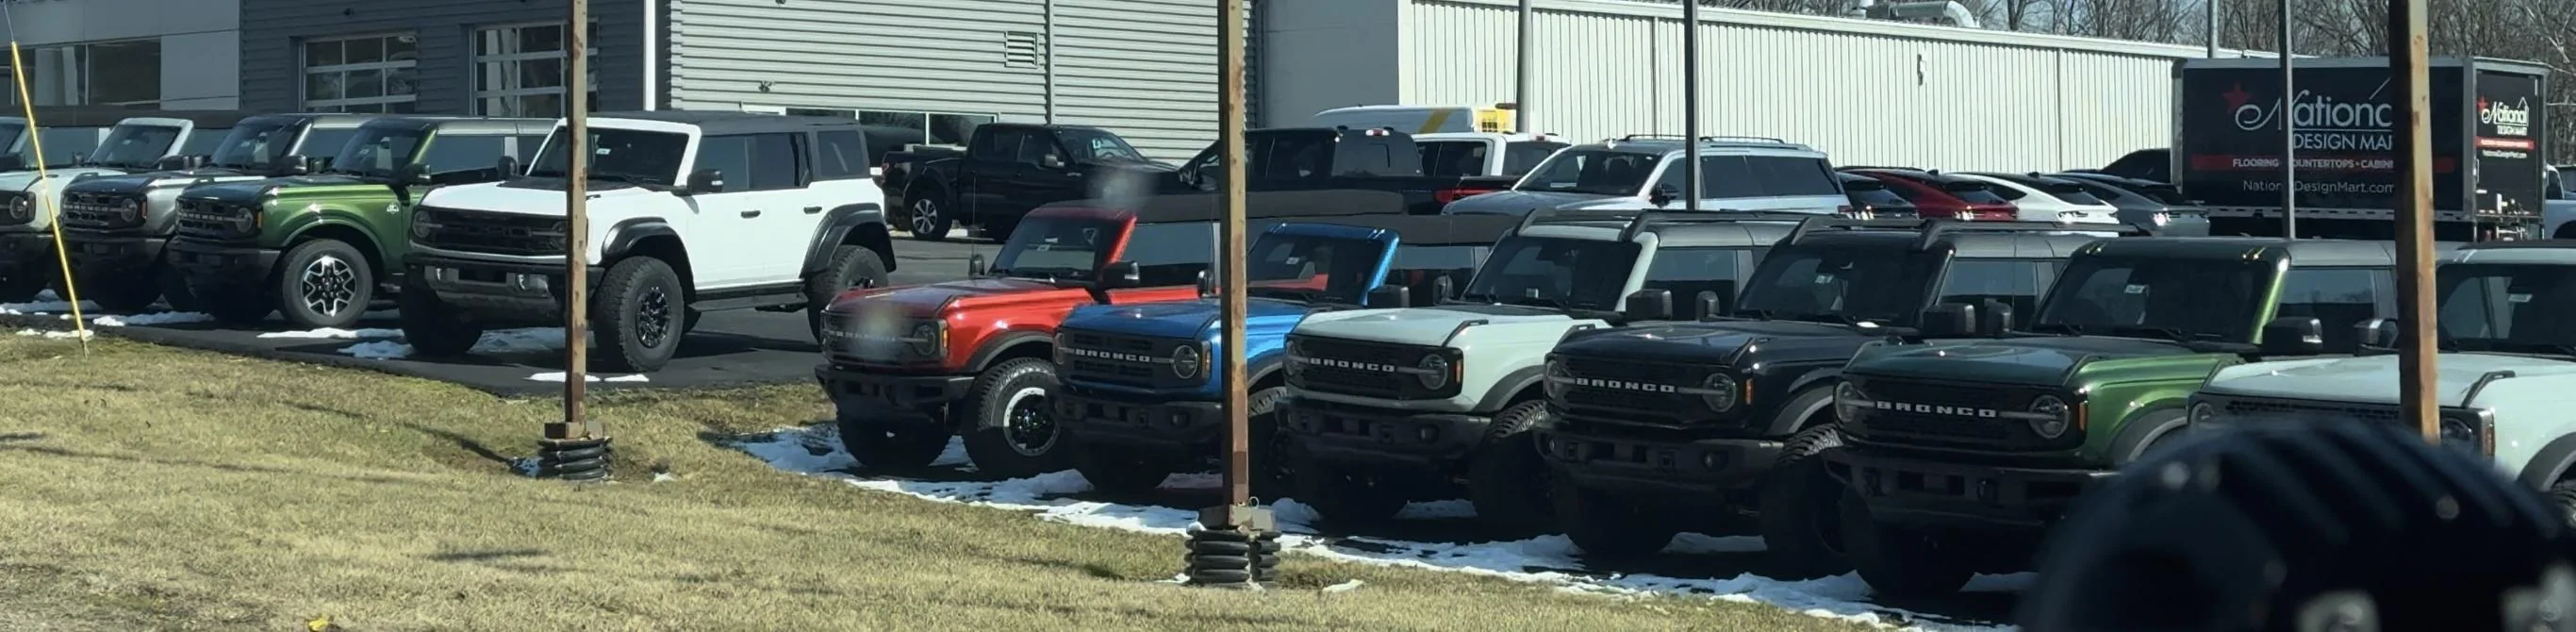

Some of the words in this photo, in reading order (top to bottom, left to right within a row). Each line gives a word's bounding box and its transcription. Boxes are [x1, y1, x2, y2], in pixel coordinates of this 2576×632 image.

[2293, 133, 2356, 150] DESIGN
[2232, 158, 2280, 168] FLOORING
[2292, 158, 2354, 169] OUNTERTOPS
[1075, 348, 1150, 363] BRONCO
[1310, 358, 1395, 373] BRONCO
[1577, 377, 1676, 393] BRONCO
[1877, 401, 1997, 418] BRONCO
